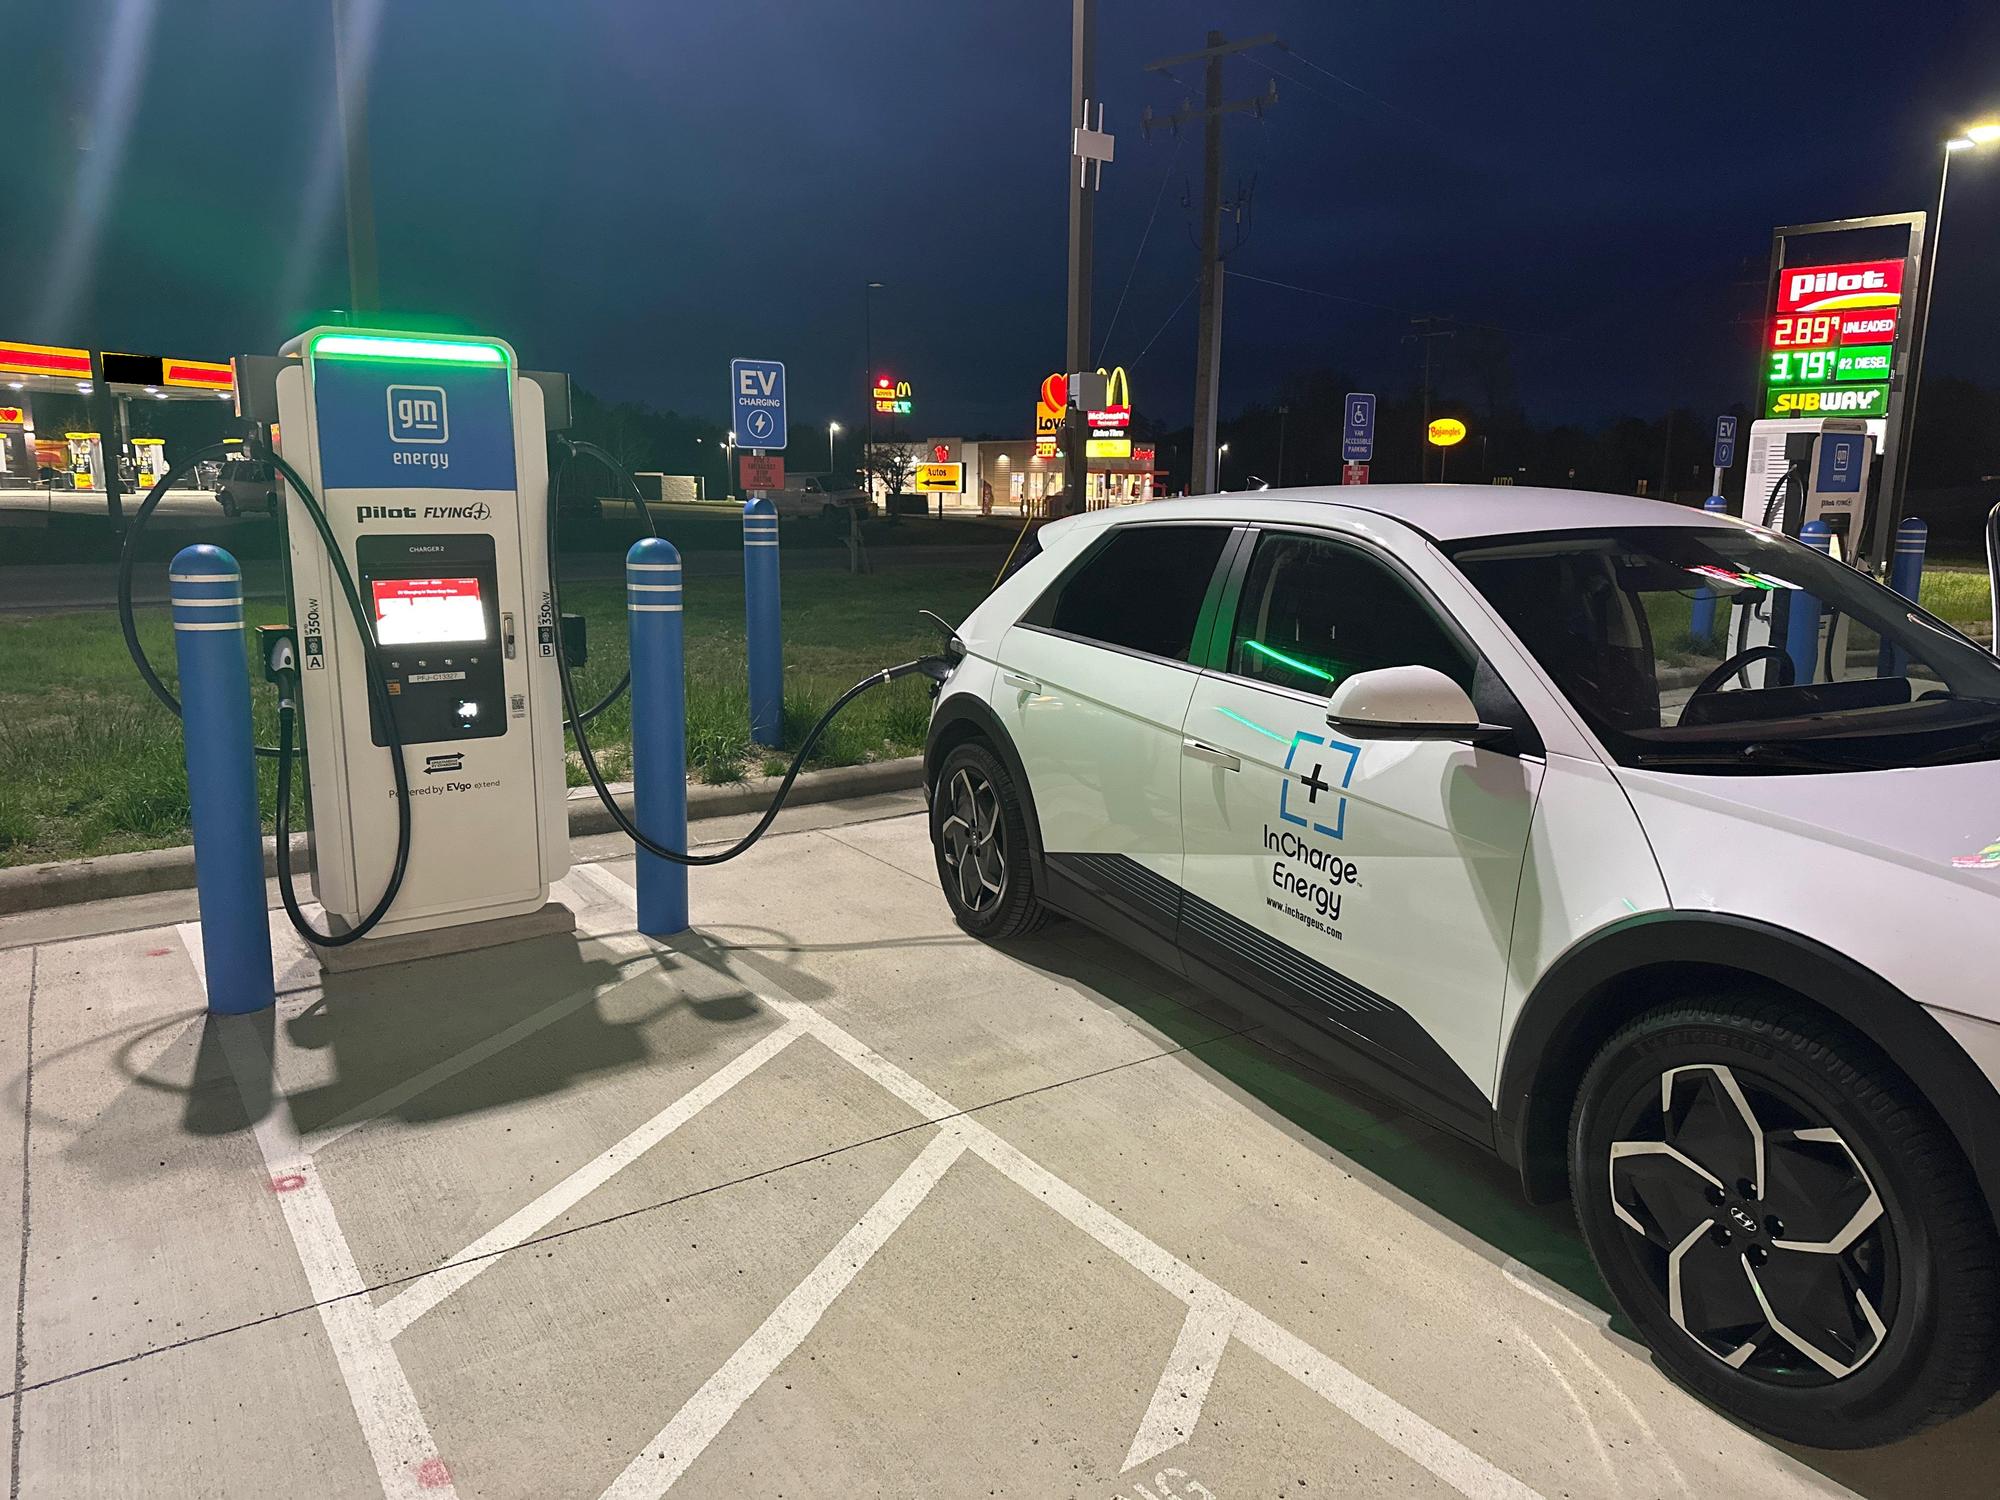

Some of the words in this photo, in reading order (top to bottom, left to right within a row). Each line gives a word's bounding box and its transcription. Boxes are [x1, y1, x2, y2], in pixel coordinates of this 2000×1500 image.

[1843, 319, 1895, 334] UNLEADED
[1838, 358, 1852, 369] #2
[1855, 356, 1889, 369] DIESEL
[740, 369, 777, 395] EV
[739, 397, 781, 407] CHARGING
[1773, 389, 1880, 413] SUBWAY
[398, 399, 438, 429] gm
[1430, 426, 1461, 438] Bojangles
[1719, 422, 1734, 437] EV
[393, 452, 449, 469] energy
[928, 467, 947, 476] Autos
[424, 507, 473, 519] FLYING
[308, 598, 321, 635] 350kW
[541, 592, 552, 625] 350kW
[542, 645, 551, 655] B
[310, 656, 321, 668] A
[388, 785, 431, 798] Poered
[432, 783, 444, 795] by
[446, 782, 472, 792] EVgo
[474, 780, 500, 790] extend
[1264, 824, 1358, 886] InCharge
[1273, 861, 1342, 921] Energy
[1266, 896, 1343, 941] www.inchargeus.com
